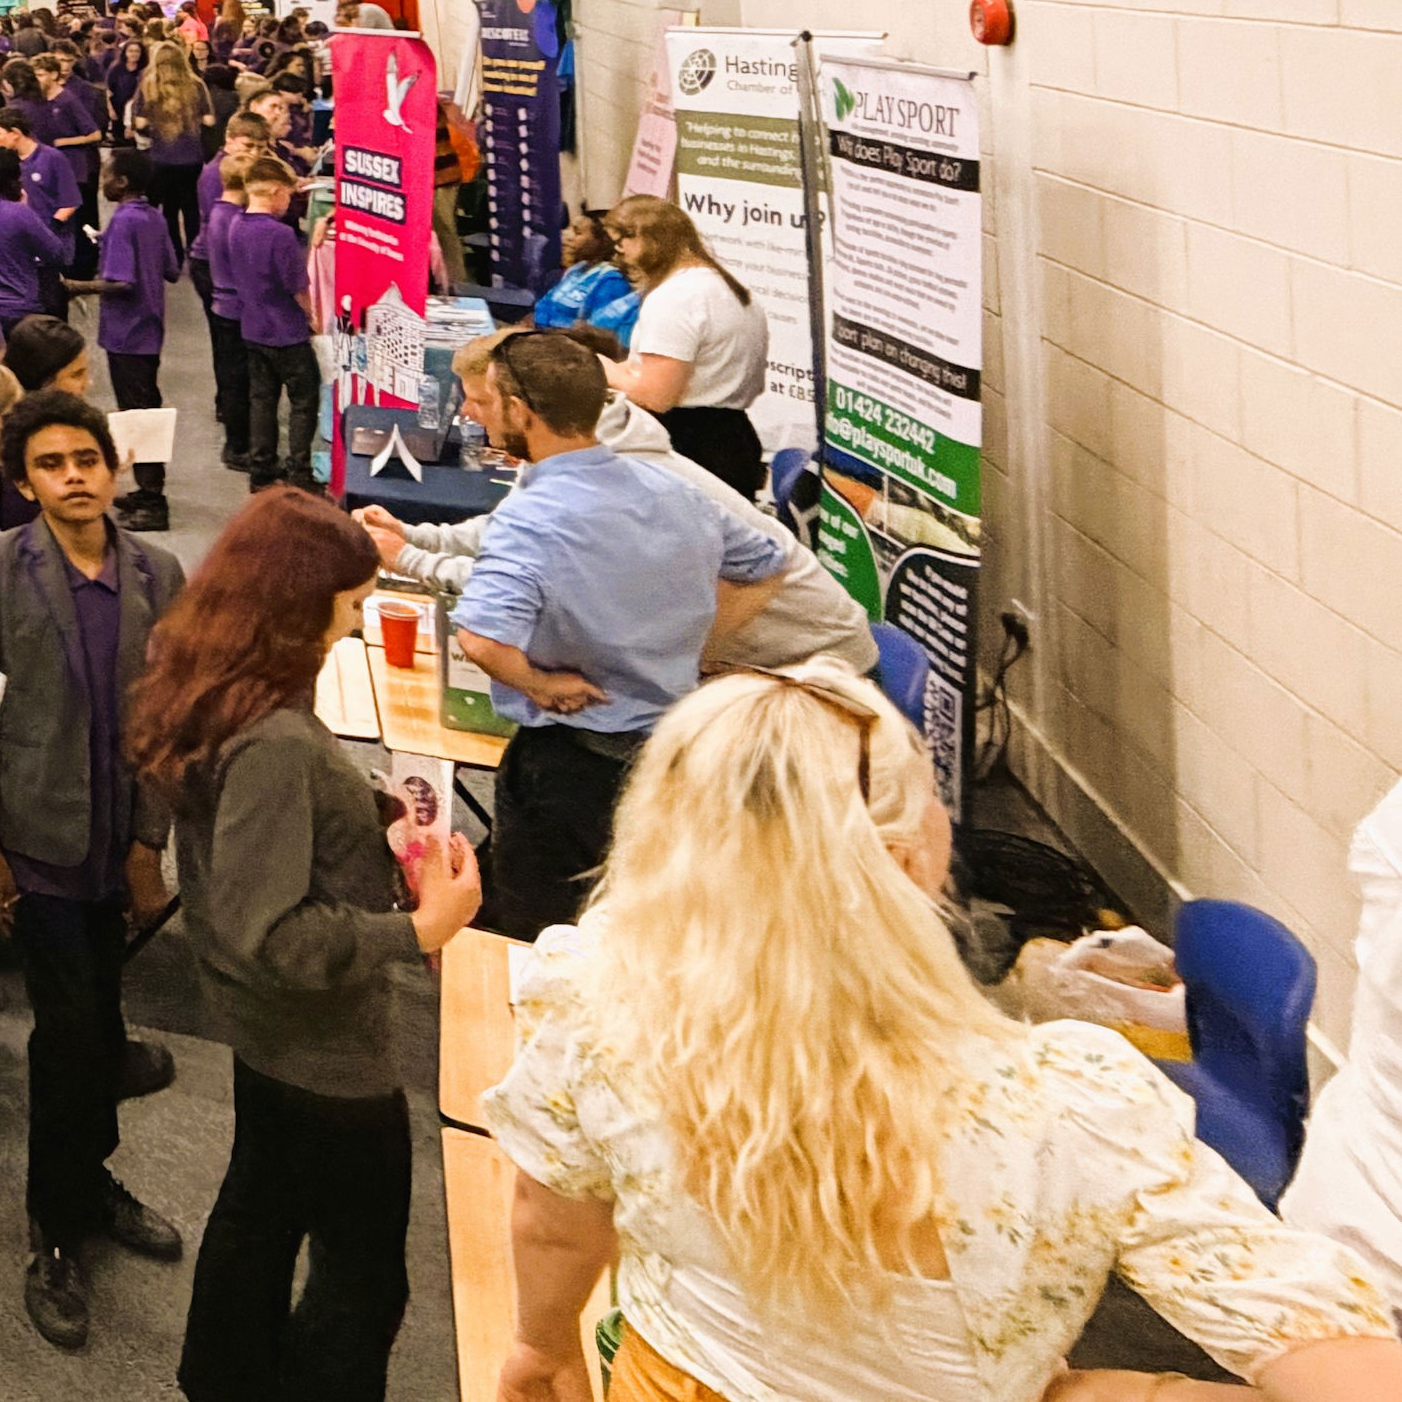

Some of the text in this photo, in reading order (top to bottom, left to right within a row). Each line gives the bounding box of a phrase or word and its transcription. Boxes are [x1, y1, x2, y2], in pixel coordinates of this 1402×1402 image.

[725, 55, 798, 83] Hasting
[726, 79, 776, 95] Chamber
[854, 91, 896, 125] PLAY
[897, 98, 961, 138] SPORT
[344, 149, 401, 185] SUSSEX
[939, 157, 963, 182] do?
[340, 180, 405, 221] INSPIRES
[684, 192, 736, 223] Why
[743, 200, 783, 226] join
[790, 211, 826, 232] u?
[770, 381, 784, 394] at
[835, 385, 936, 456] 01424 232442
